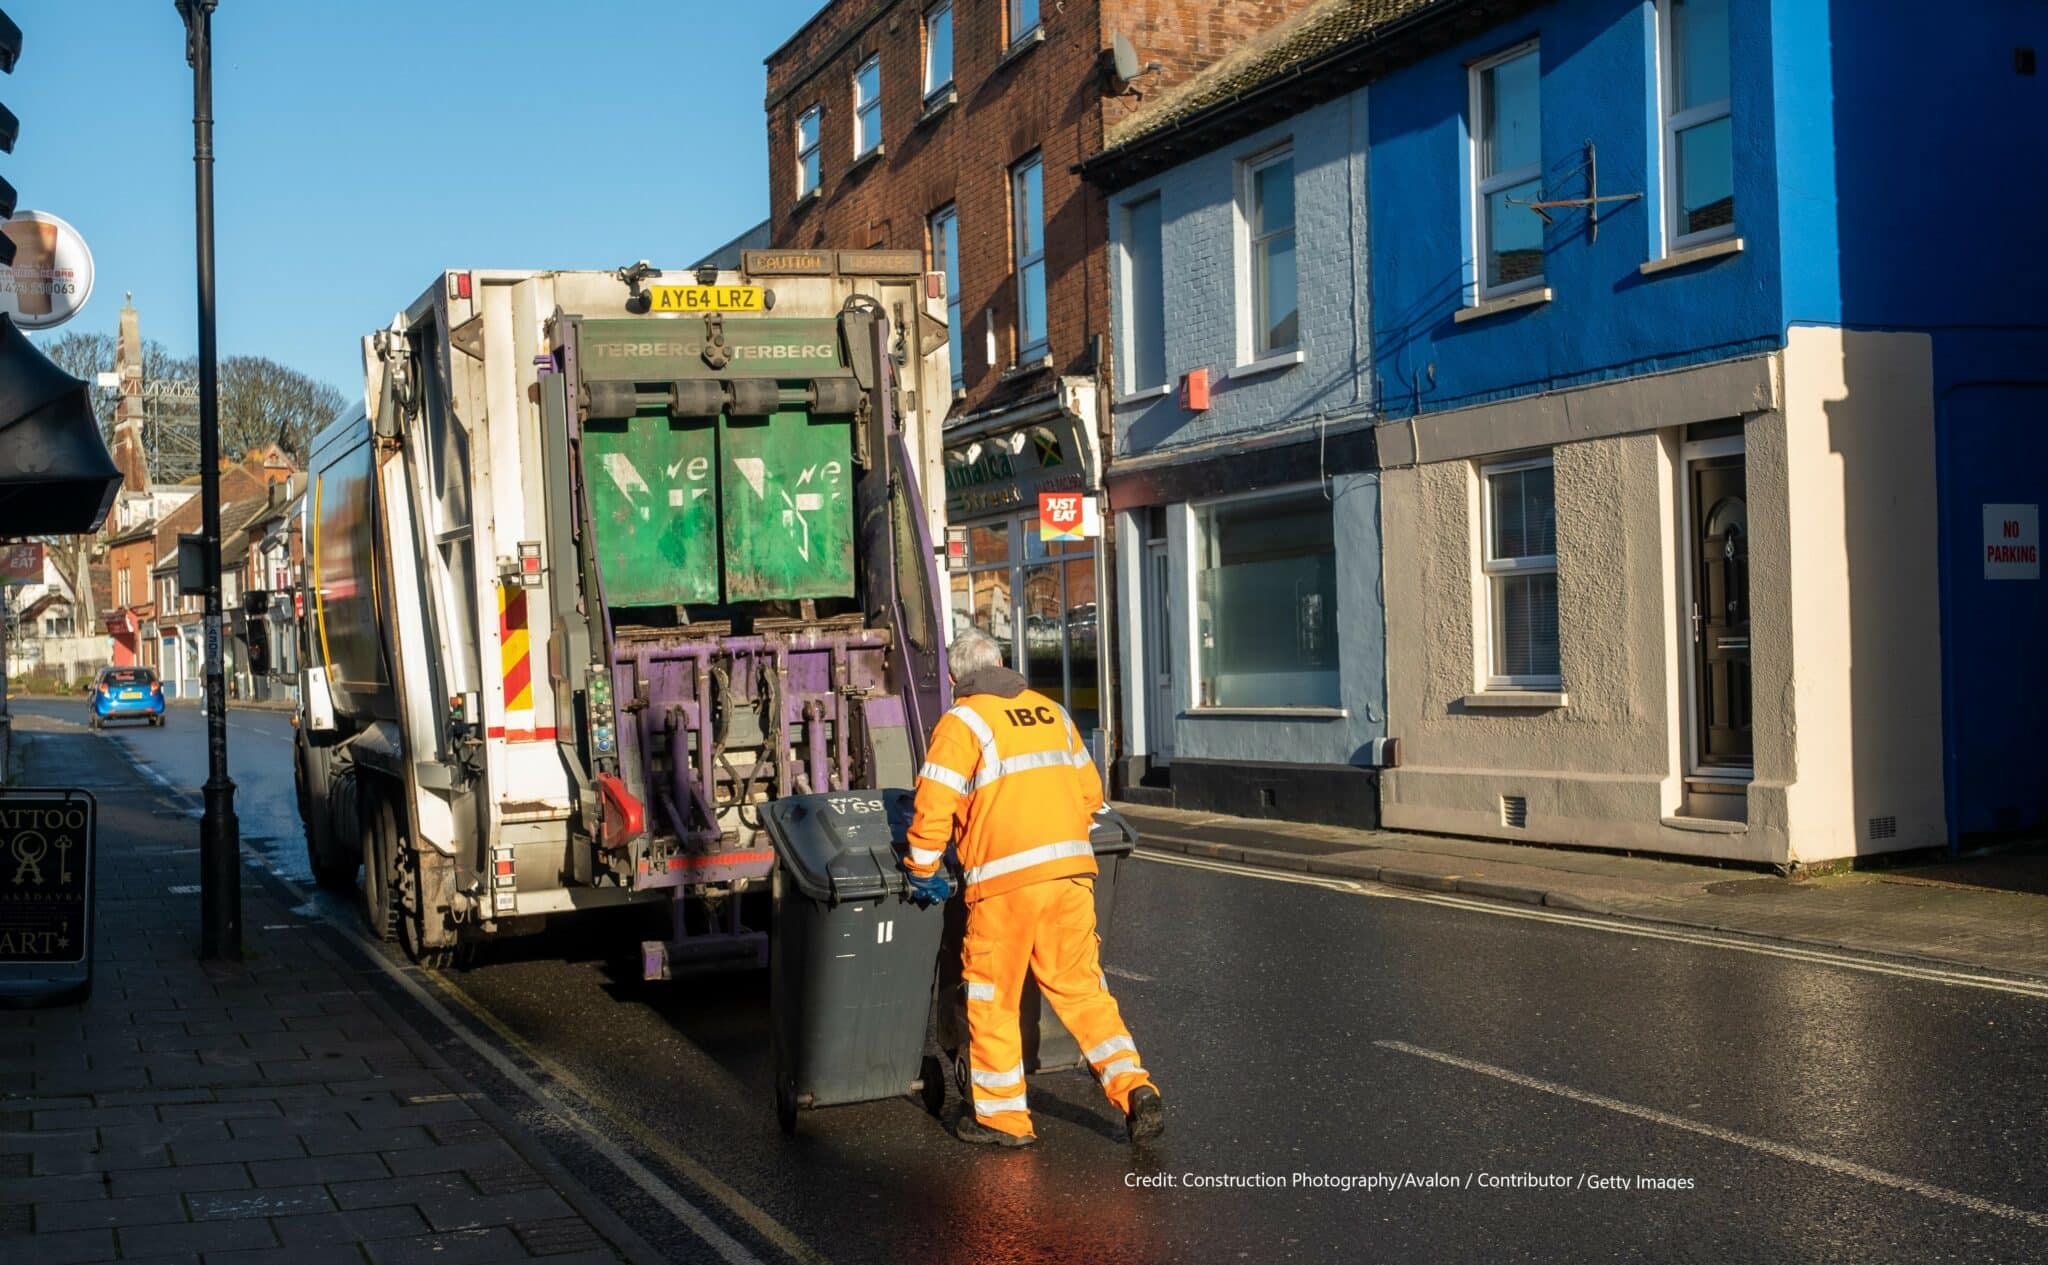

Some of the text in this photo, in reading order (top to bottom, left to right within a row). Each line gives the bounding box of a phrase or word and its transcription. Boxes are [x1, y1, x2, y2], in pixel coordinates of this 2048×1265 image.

[757, 255, 821, 270] CAUTION
[661, 290, 754, 307] AY64 LRZ
[594, 343, 833, 359] TERBERG TERBERG
[1046, 498, 1077, 511] JUST
[1053, 510, 1077, 522] EAT
[2003, 520, 2019, 538] NO
[1987, 545, 2036, 563] PARKING
[10, 557, 36, 568] EAT
[1004, 706, 1055, 727] IBC
